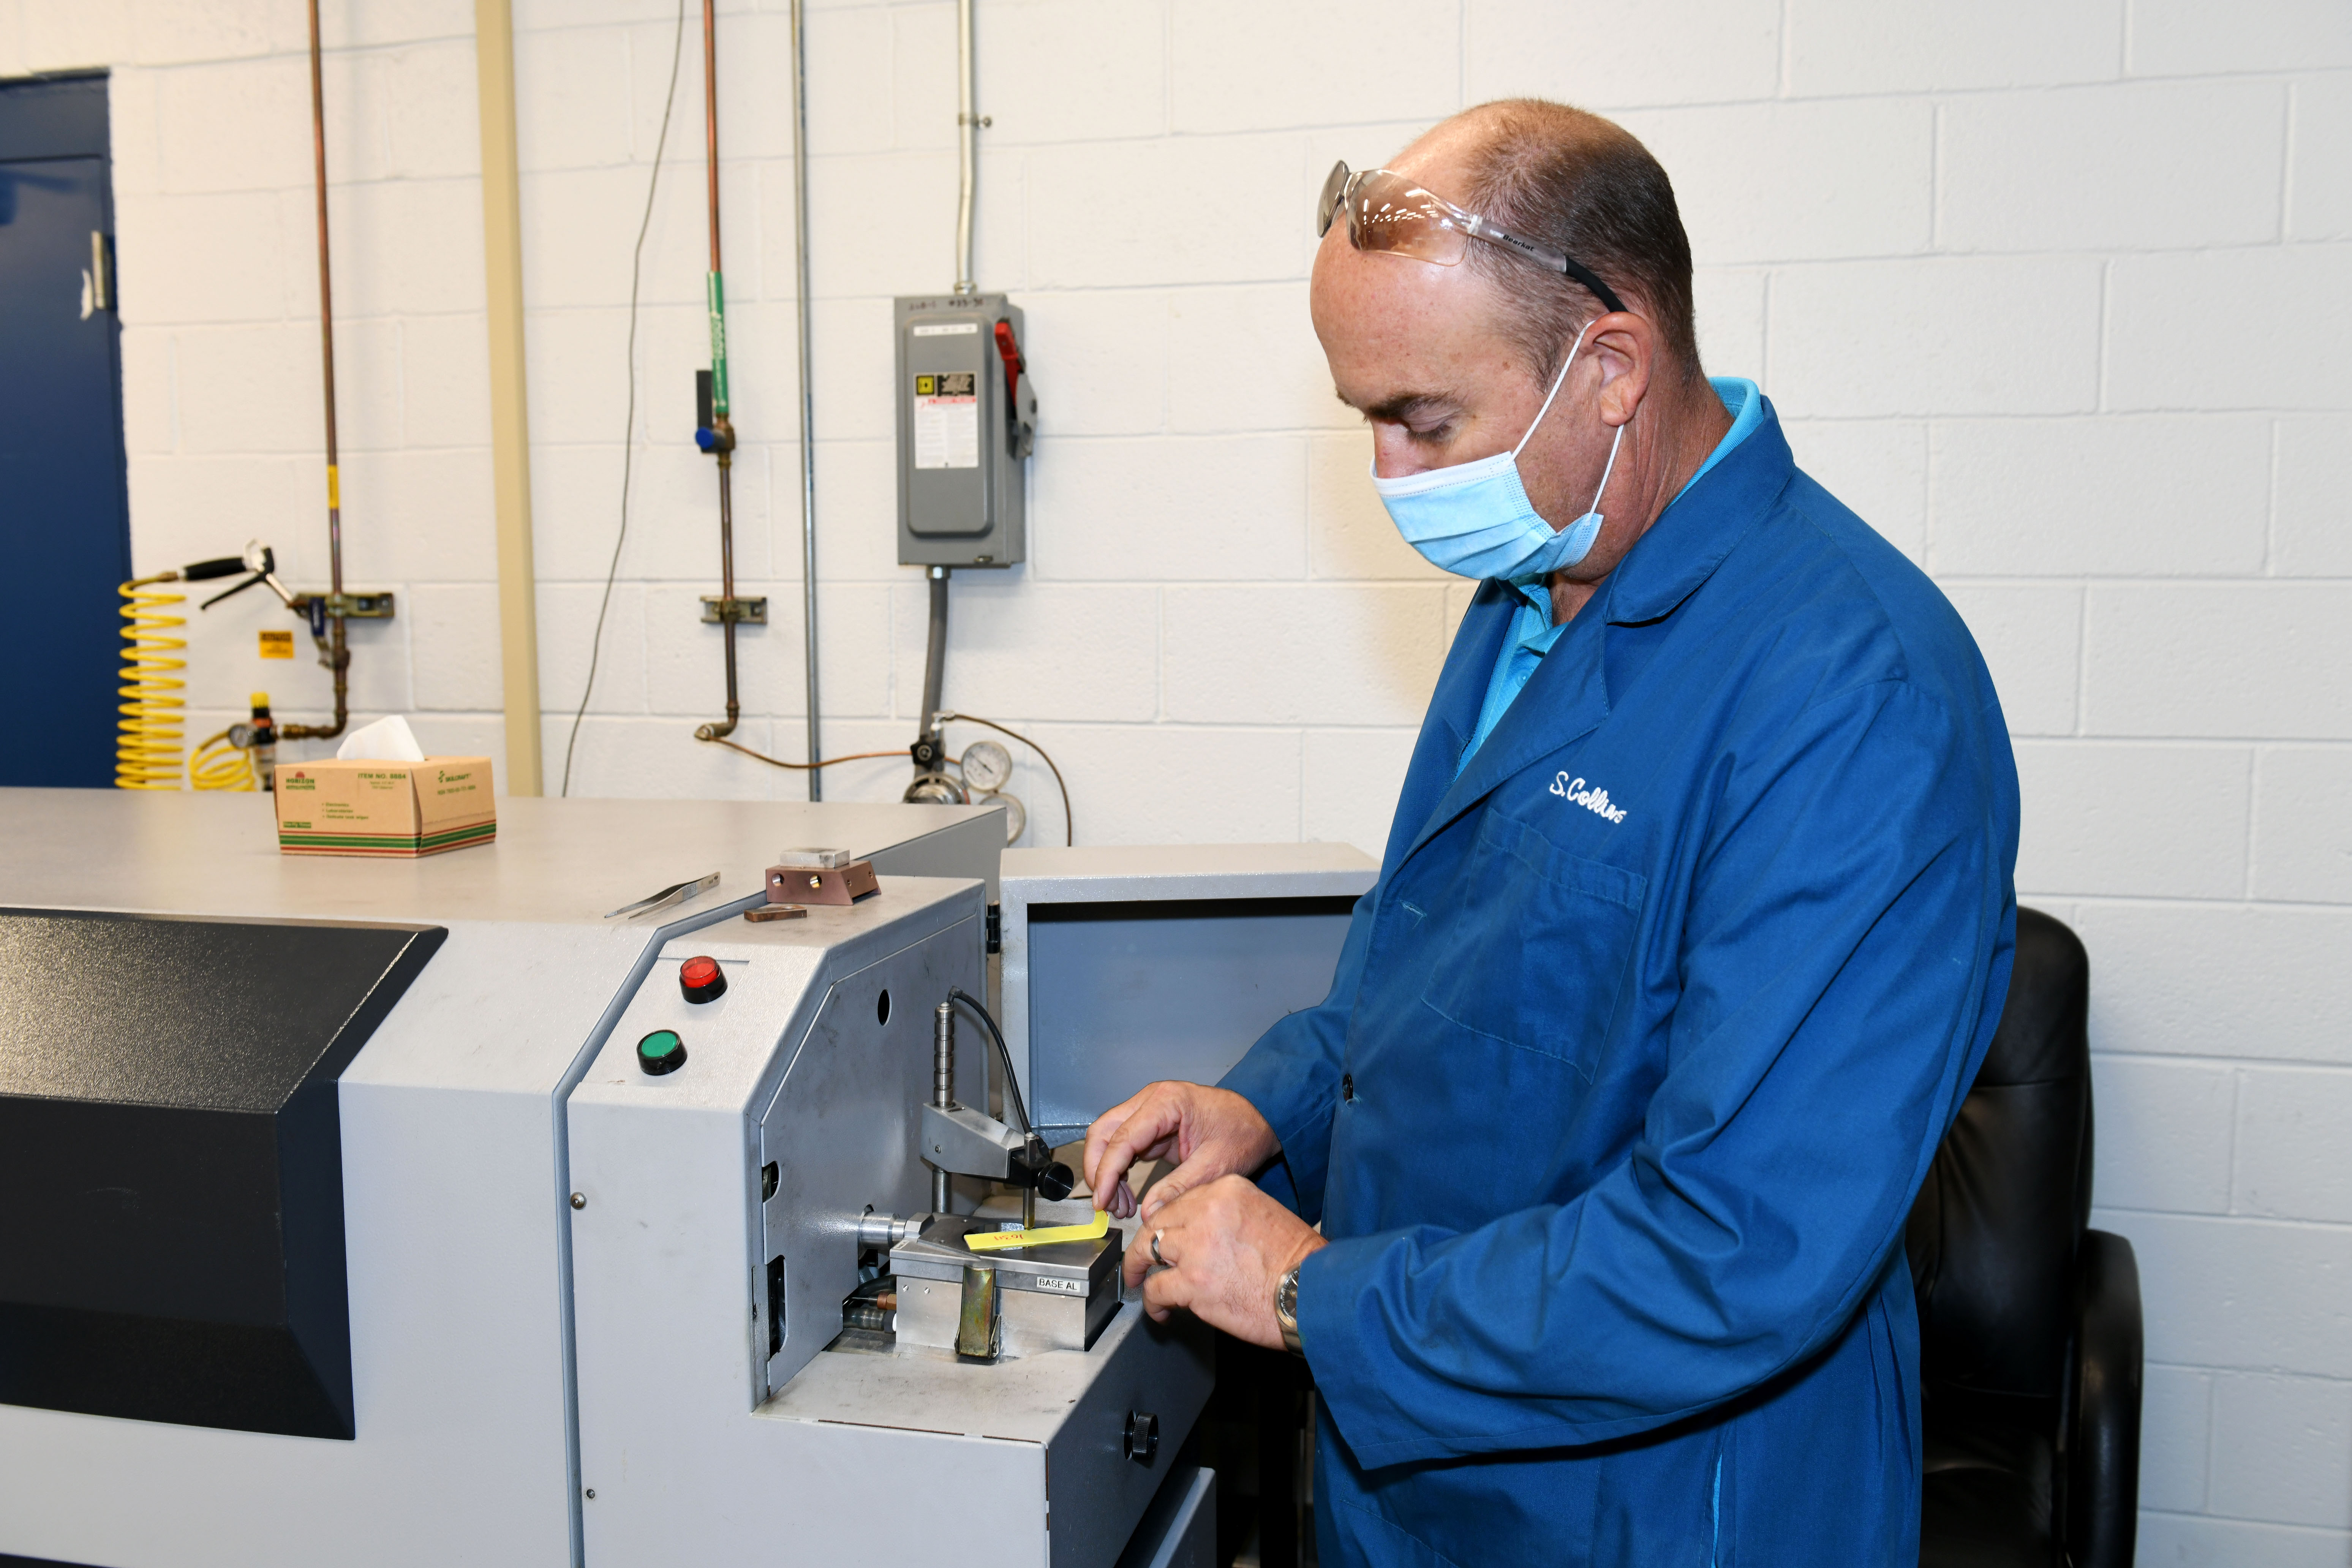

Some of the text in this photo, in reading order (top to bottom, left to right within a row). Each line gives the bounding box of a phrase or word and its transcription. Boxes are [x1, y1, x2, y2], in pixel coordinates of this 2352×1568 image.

[1503, 234, 1535, 251] Bearkat
[1039, 1278, 1078, 1290] BASE AL
